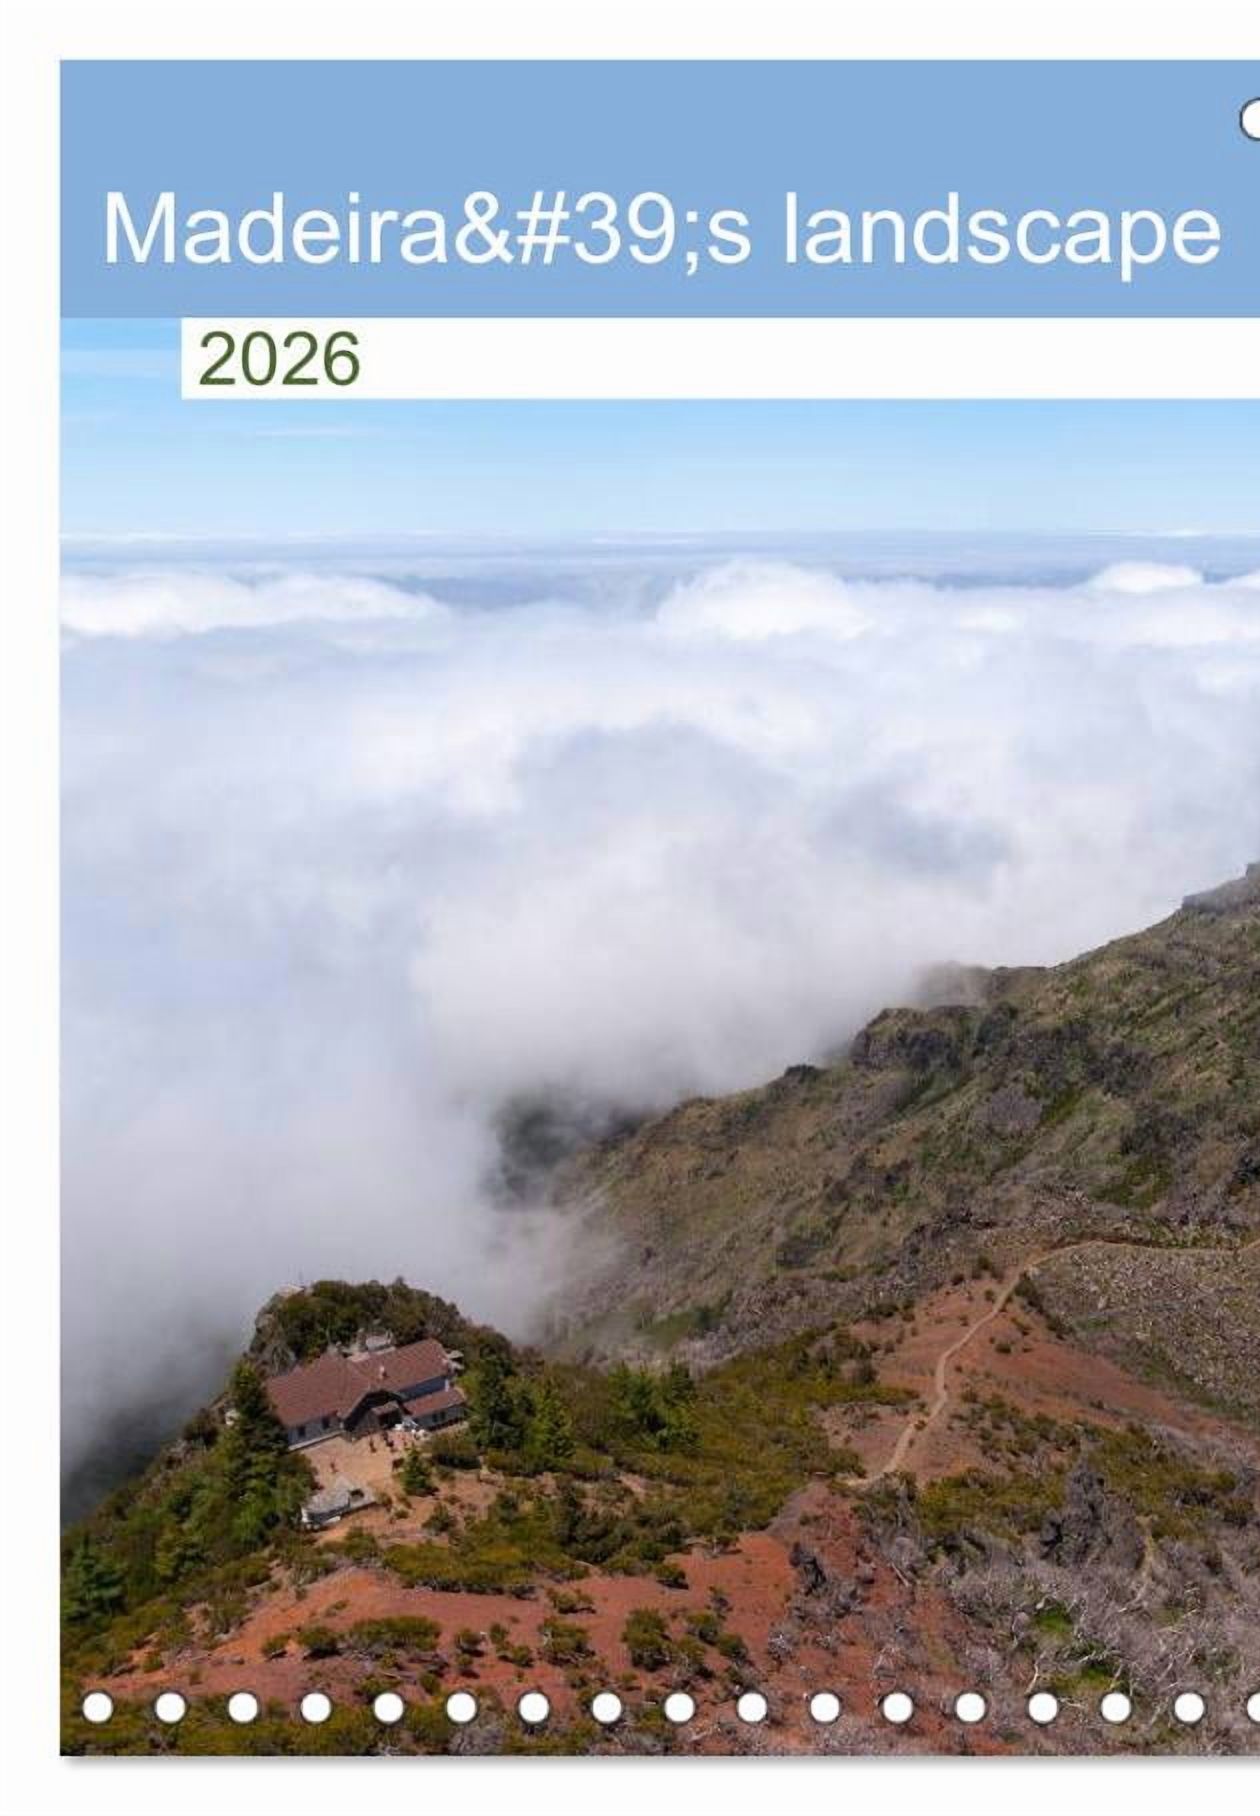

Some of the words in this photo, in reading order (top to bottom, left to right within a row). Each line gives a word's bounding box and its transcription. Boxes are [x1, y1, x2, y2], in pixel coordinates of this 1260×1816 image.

[103, 190, 752, 276] Madeira&#39;s
[785, 190, 1222, 281] landscape
[198, 330, 361, 386] 2026
